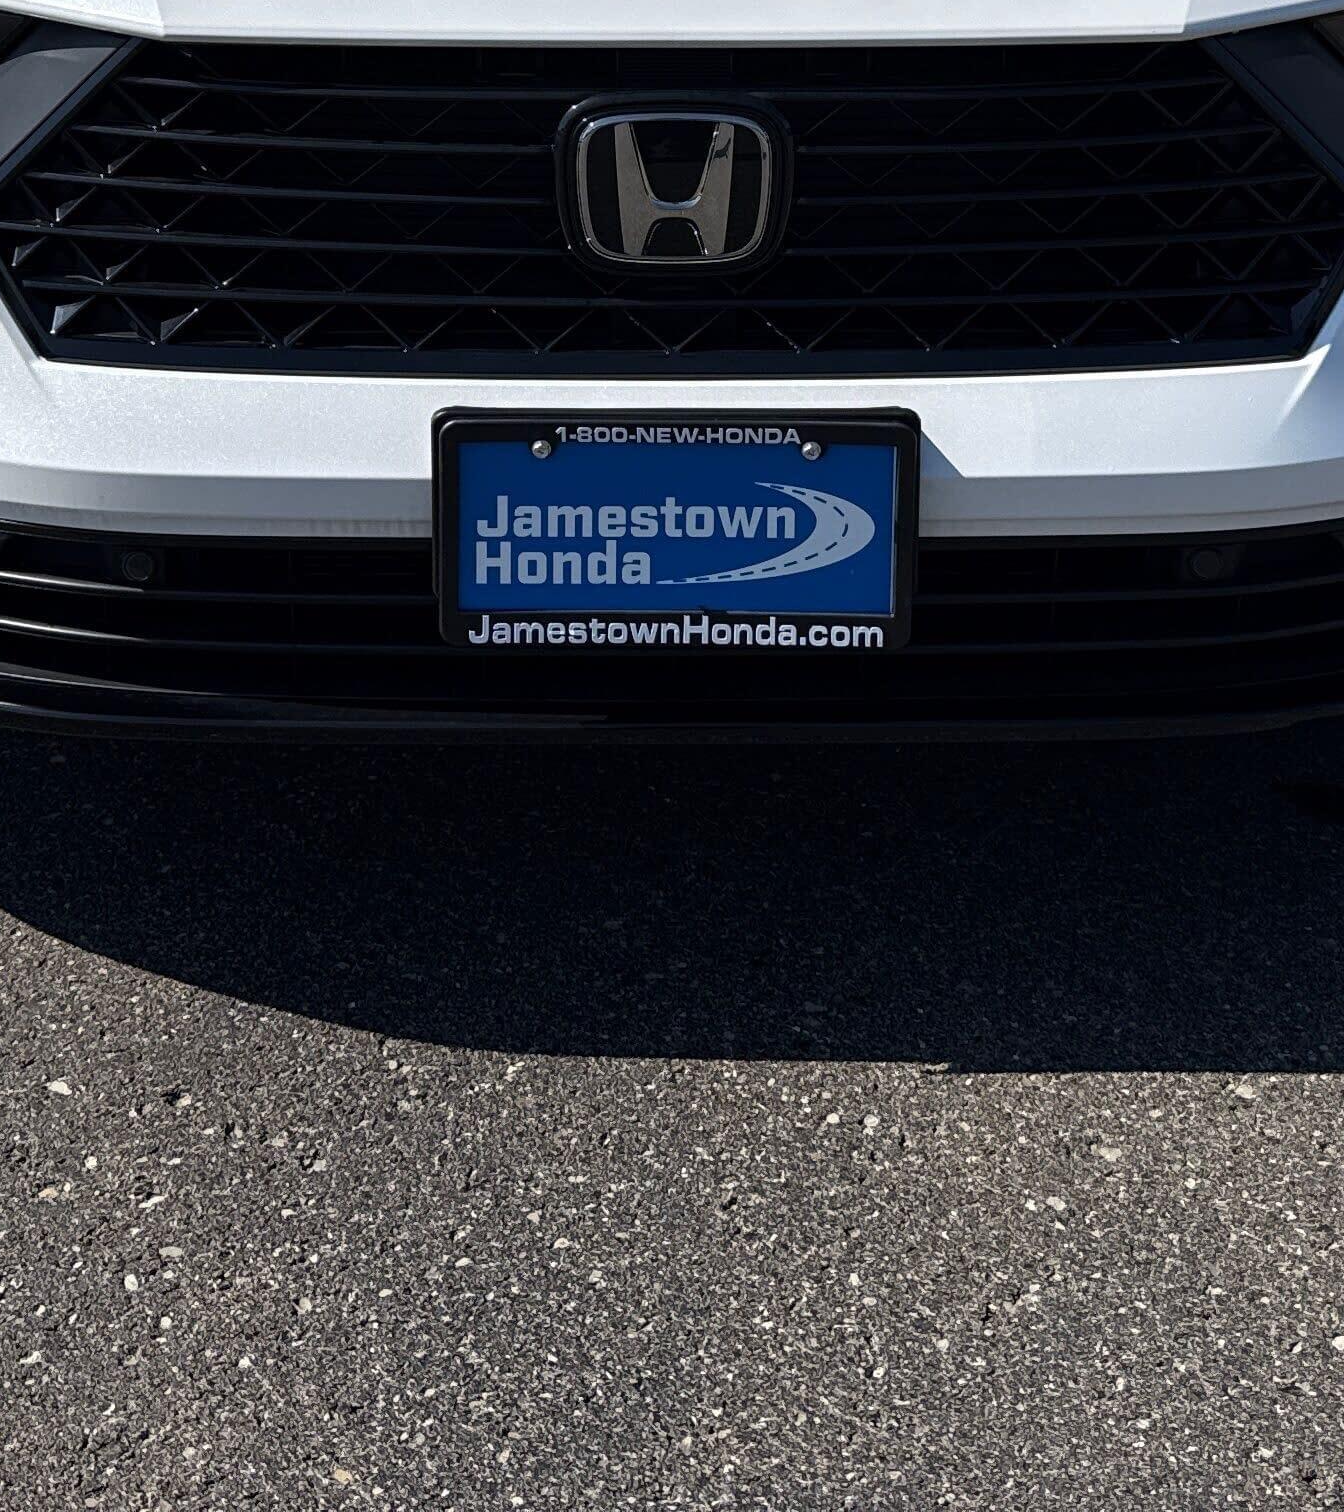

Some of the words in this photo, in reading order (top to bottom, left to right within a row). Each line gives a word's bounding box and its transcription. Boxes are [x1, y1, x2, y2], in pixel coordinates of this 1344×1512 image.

[555, 426, 801, 445] 1-800-NEW-HONDA
[476, 495, 796, 539] Jamestown
[475, 539, 651, 585] Honda
[468, 614, 884, 648] JamestownHonda.com
